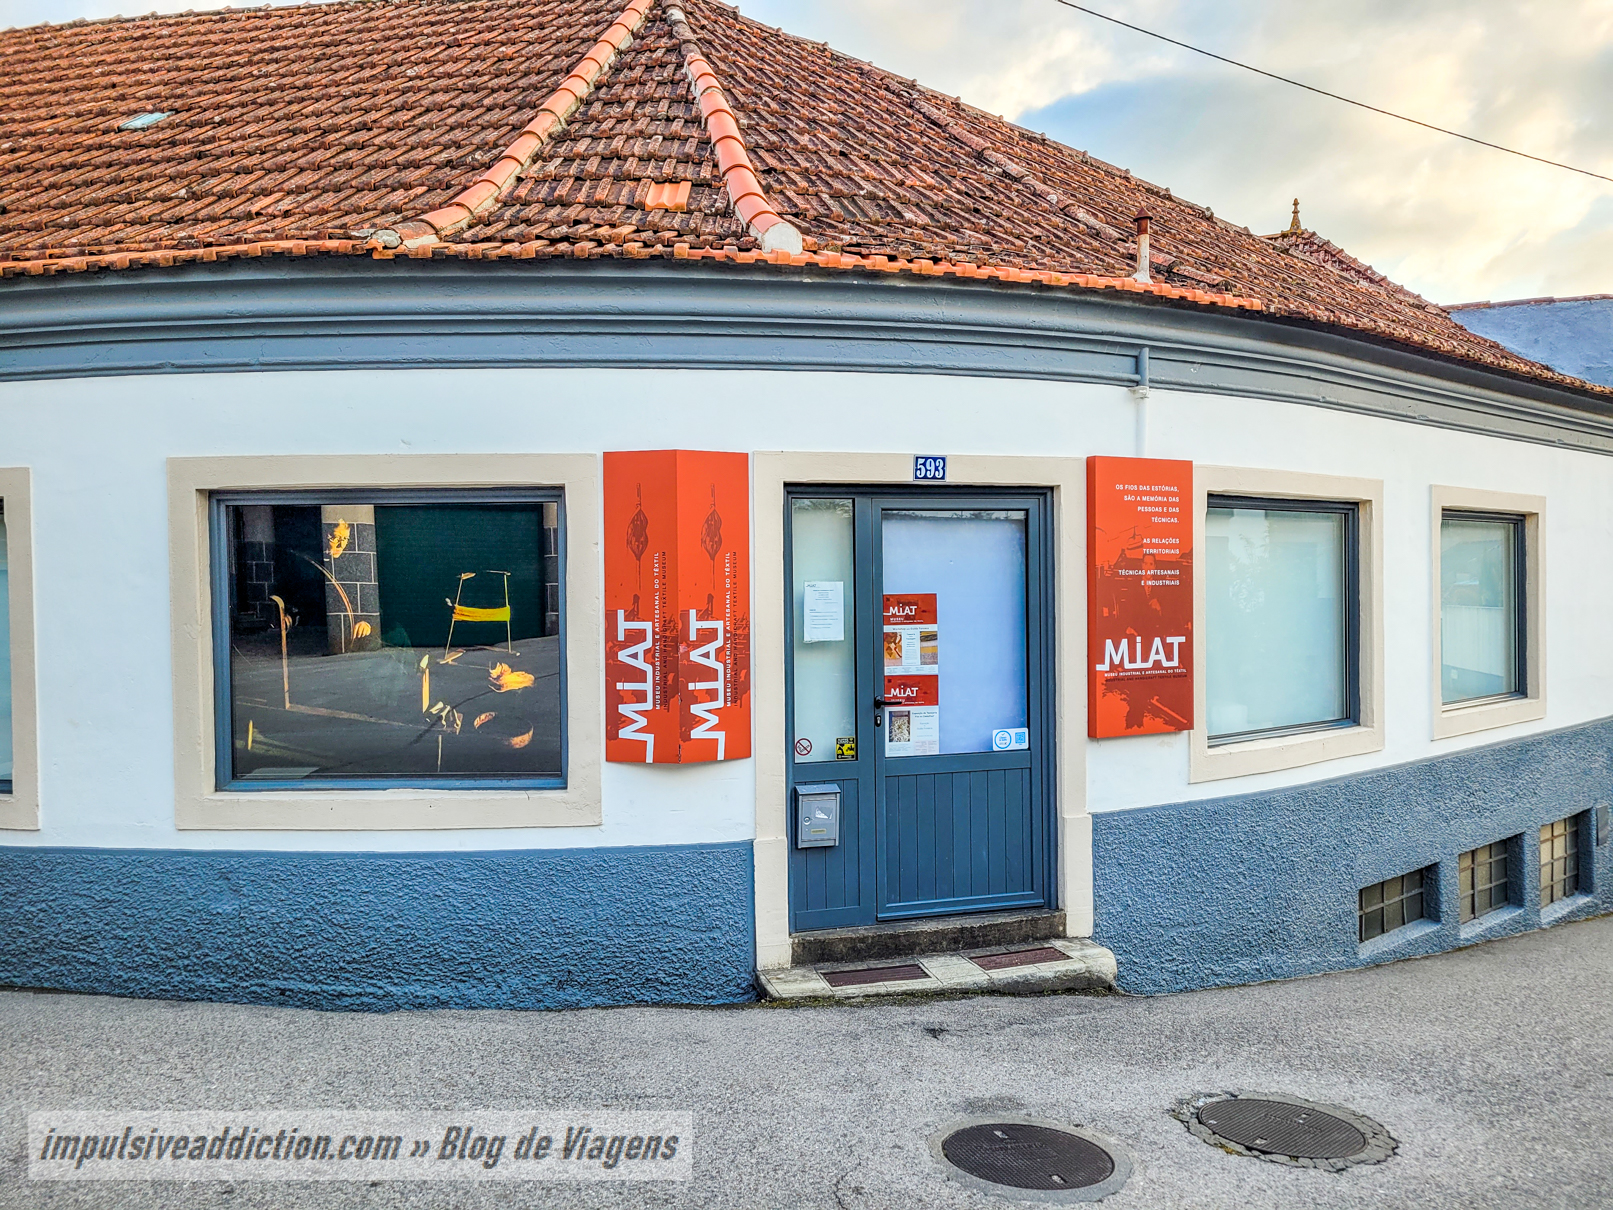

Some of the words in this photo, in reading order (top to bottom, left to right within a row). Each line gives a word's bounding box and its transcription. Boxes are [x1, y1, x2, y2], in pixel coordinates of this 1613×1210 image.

[916, 458, 944, 478] 593
[1152, 537, 1180, 545] RELAÇÕES
[654, 578, 660, 589] DO
[726, 578, 730, 588] DO
